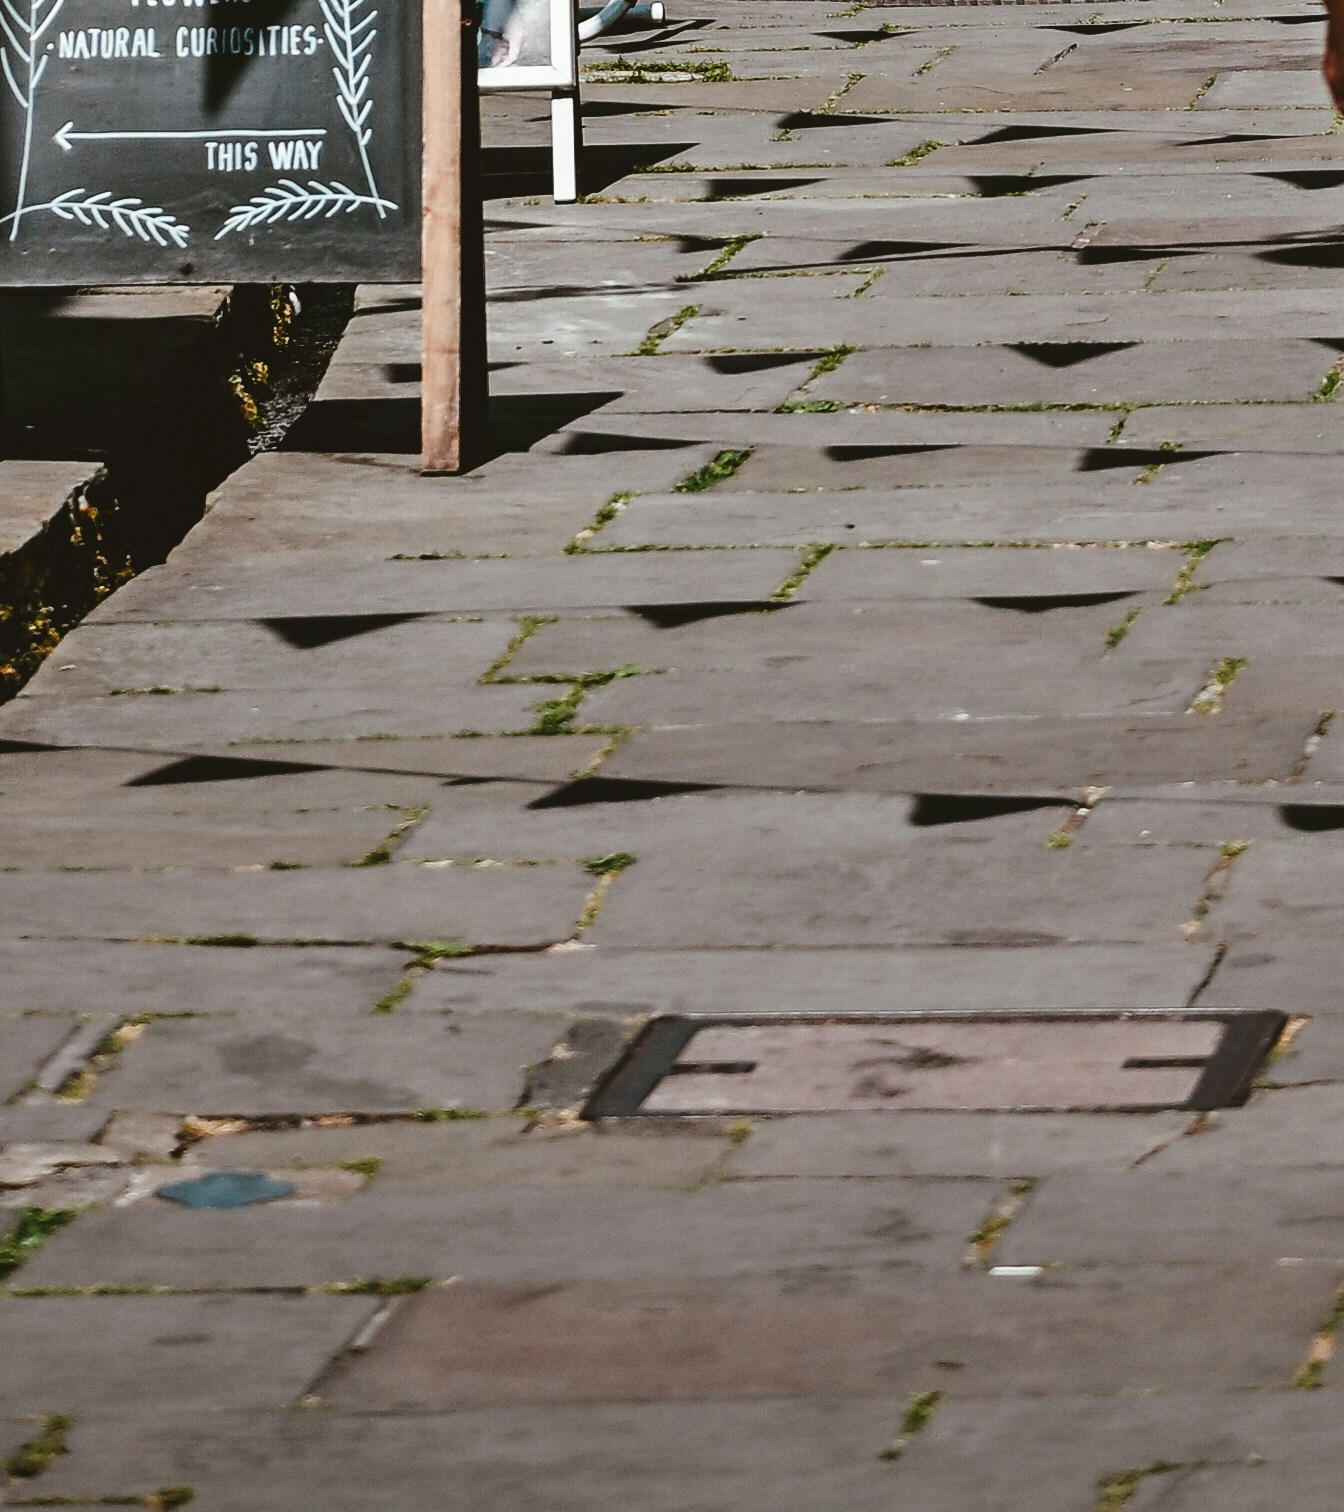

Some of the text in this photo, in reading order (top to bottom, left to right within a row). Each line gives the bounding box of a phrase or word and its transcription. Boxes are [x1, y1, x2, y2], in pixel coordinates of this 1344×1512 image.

[58, 25, 318, 59] NATURAL CURIOSITIES
[205, 140, 323, 172] THIS WAY
